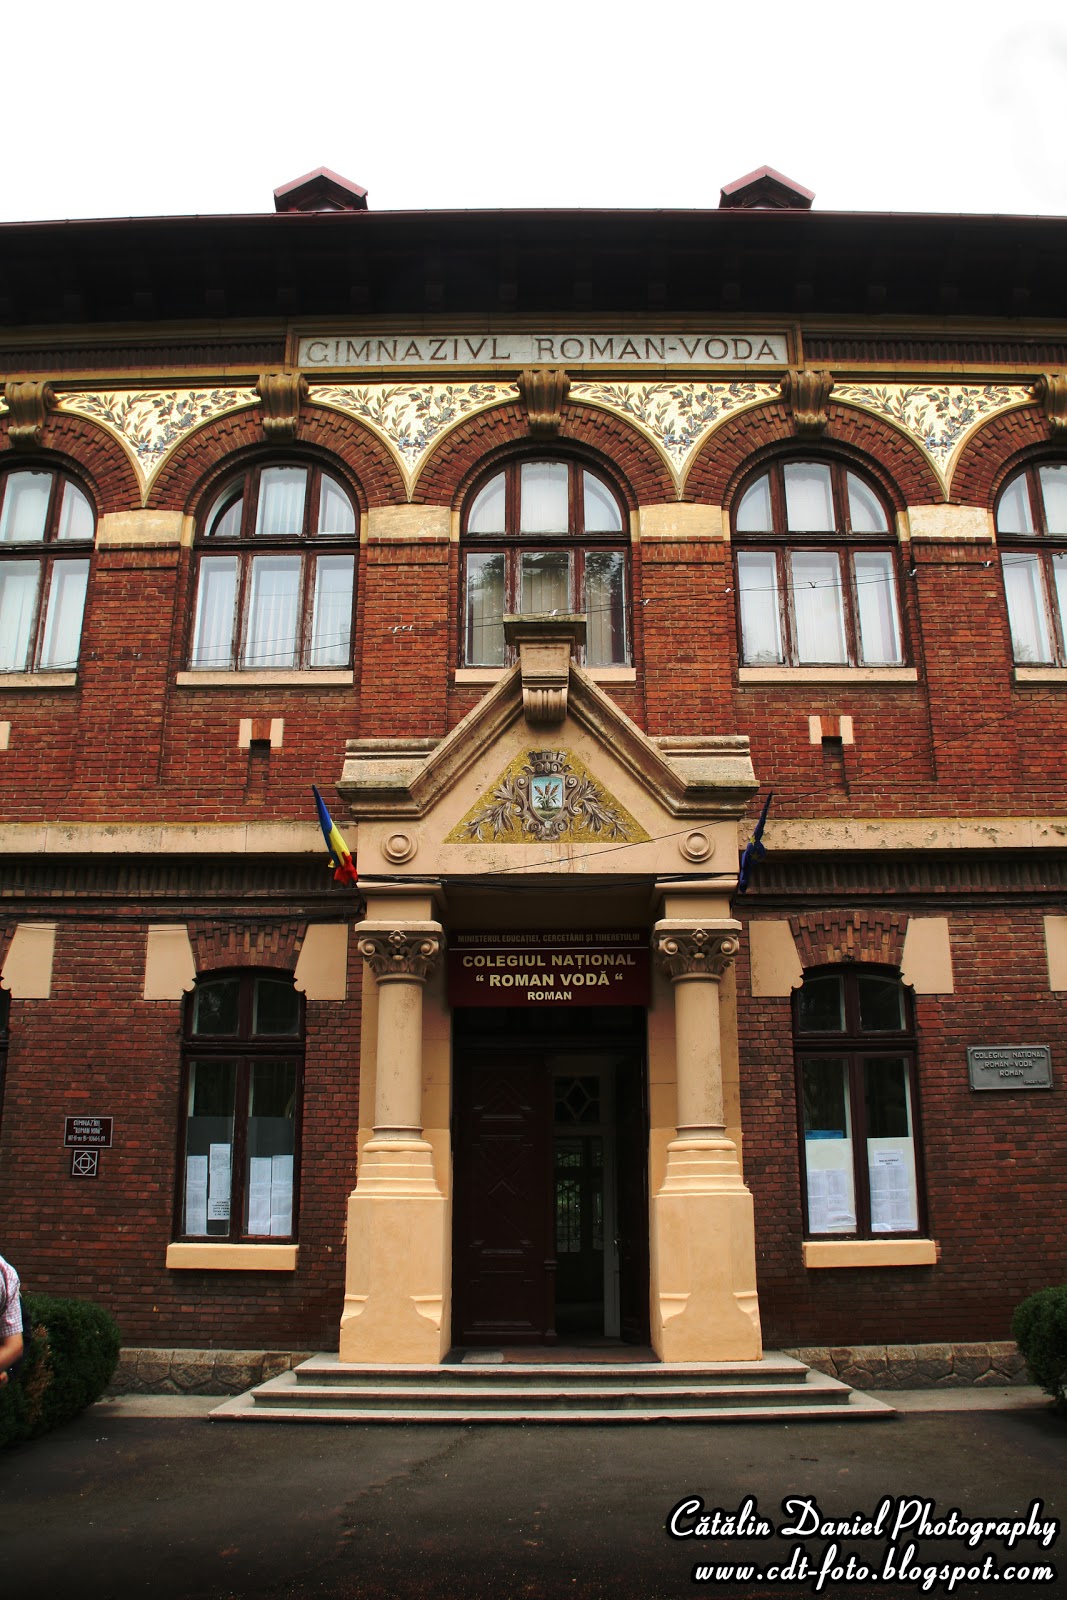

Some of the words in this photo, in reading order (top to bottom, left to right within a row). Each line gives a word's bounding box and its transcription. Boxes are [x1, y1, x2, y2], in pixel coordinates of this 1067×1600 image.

[306, 338, 511, 363] GIMNAZIVL
[536, 337, 779, 361] ROMAN-VODA
[457, 935, 501, 943] MINISTERUL
[595, 933, 640, 942] TINERETULUI
[462, 955, 546, 967] COLEGIUL
[551, 954, 636, 969] NAȚIONAL
[489, 974, 554, 987] ROMAN
[560, 971, 610, 986] VODĂ
[527, 991, 572, 1001] ROMAN
[999, 1069, 1024, 1077] ROMAN
